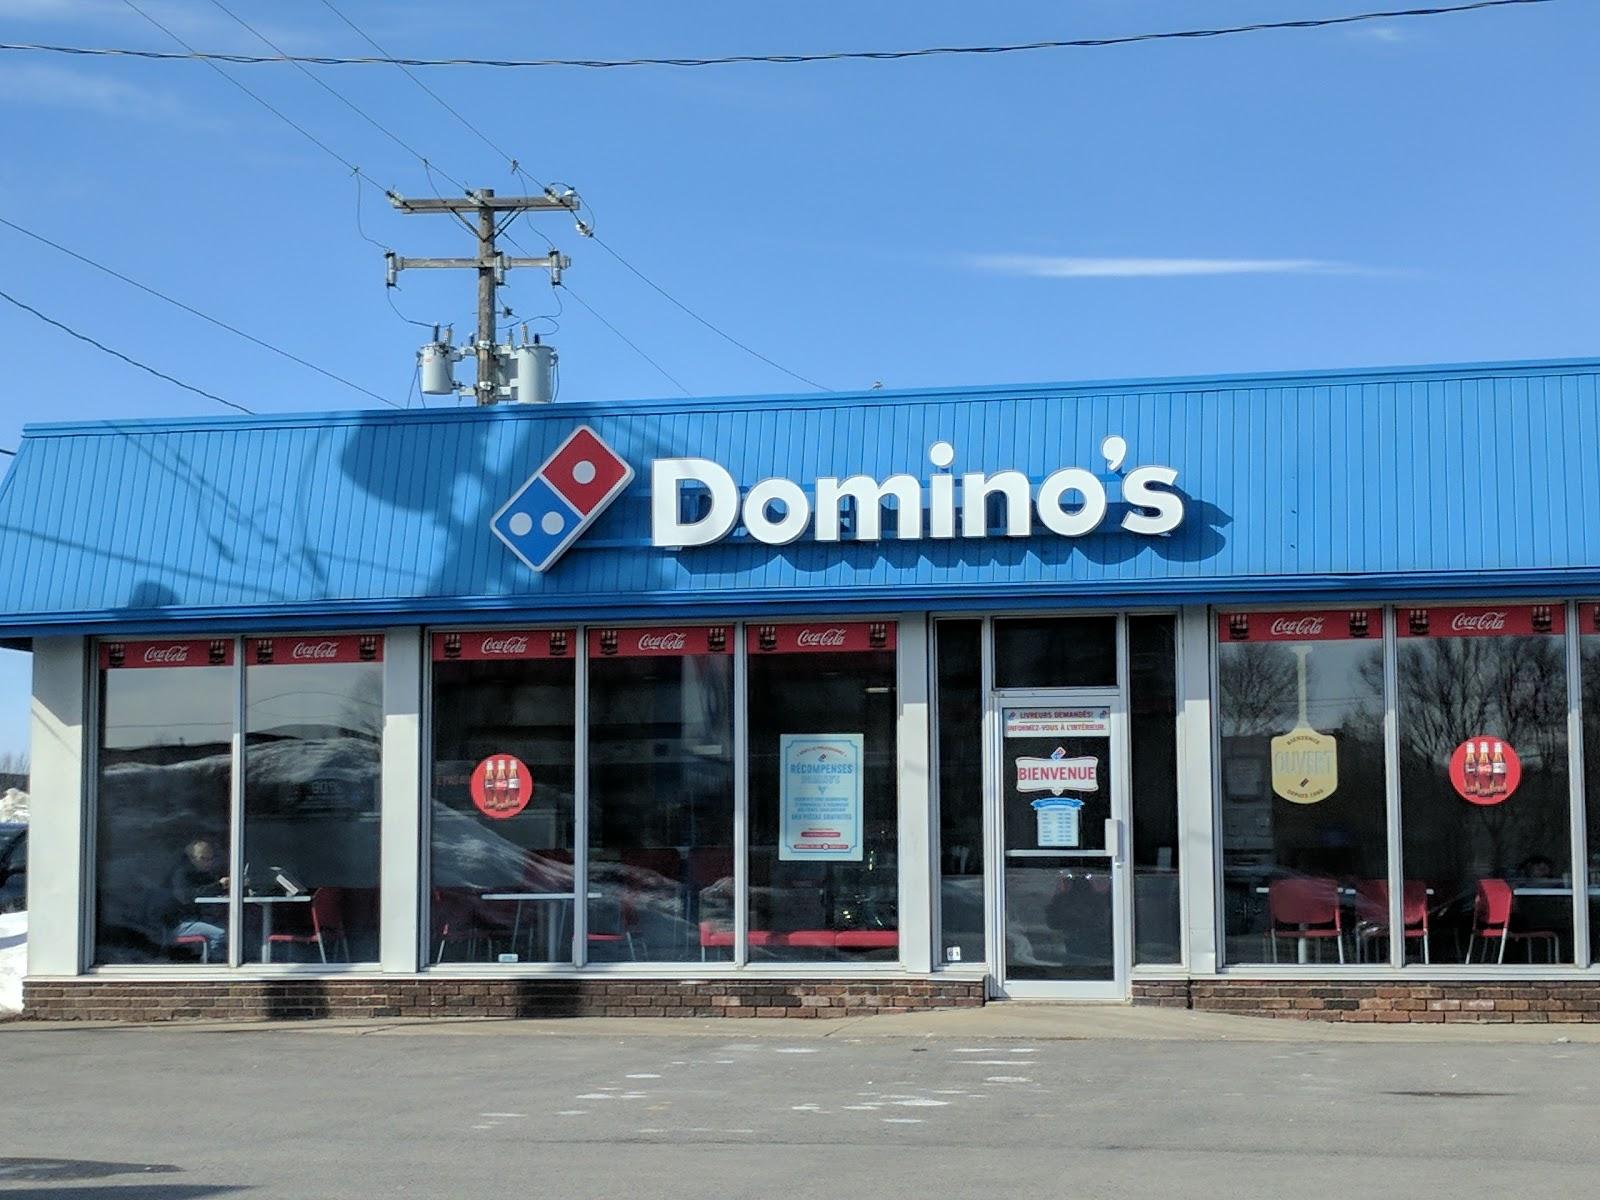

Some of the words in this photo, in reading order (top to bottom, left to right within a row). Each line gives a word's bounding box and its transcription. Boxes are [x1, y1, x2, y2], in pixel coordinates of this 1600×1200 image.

[652, 435, 1184, 547] Domino's
[790, 761, 853, 774] RÉCOMPENSES
[1018, 766, 1096, 781] BIENVENUE
